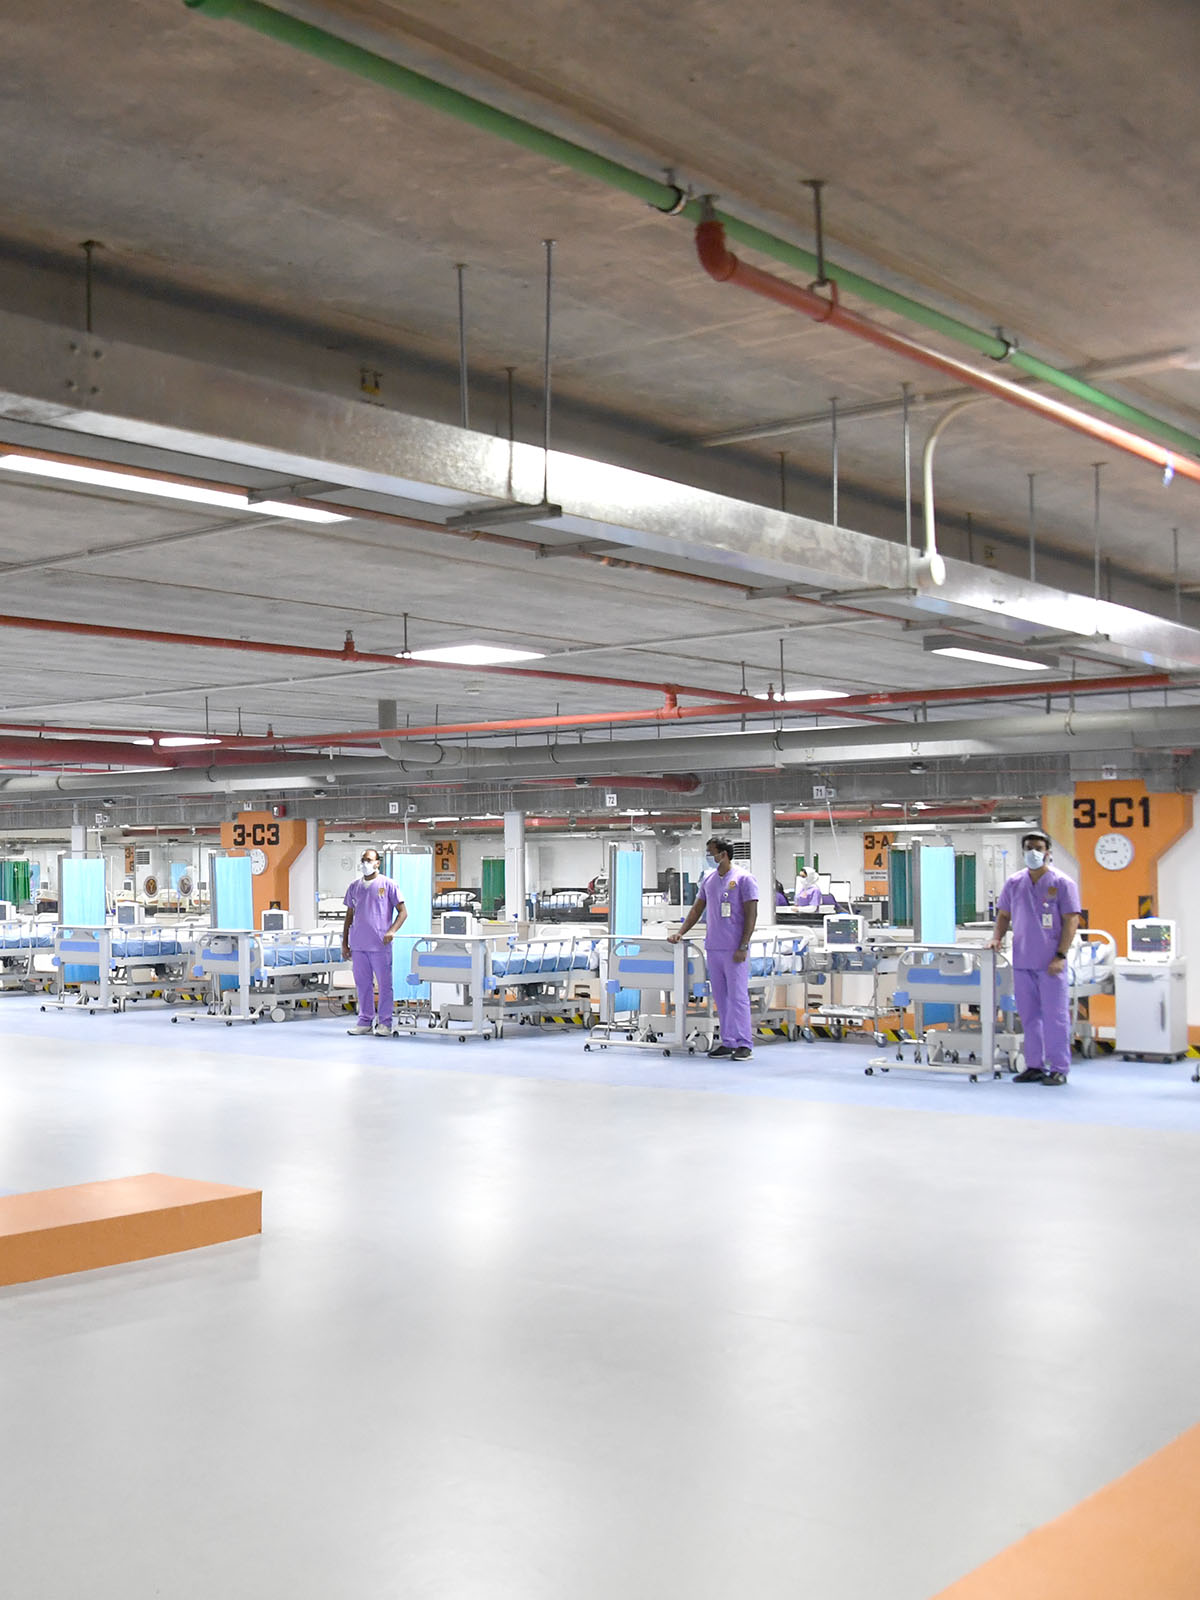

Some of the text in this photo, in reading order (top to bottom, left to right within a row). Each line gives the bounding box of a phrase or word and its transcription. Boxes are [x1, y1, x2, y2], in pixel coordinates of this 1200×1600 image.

[607, 796, 615, 805] 72
[1073, 796, 1150, 828] 3-C1
[233, 824, 280, 846] 3-C3
[864, 835, 889, 850] 3-A
[435, 843, 454, 855] 3-A
[441, 858, 450, 870] 6
[873, 853, 883, 868] 4
